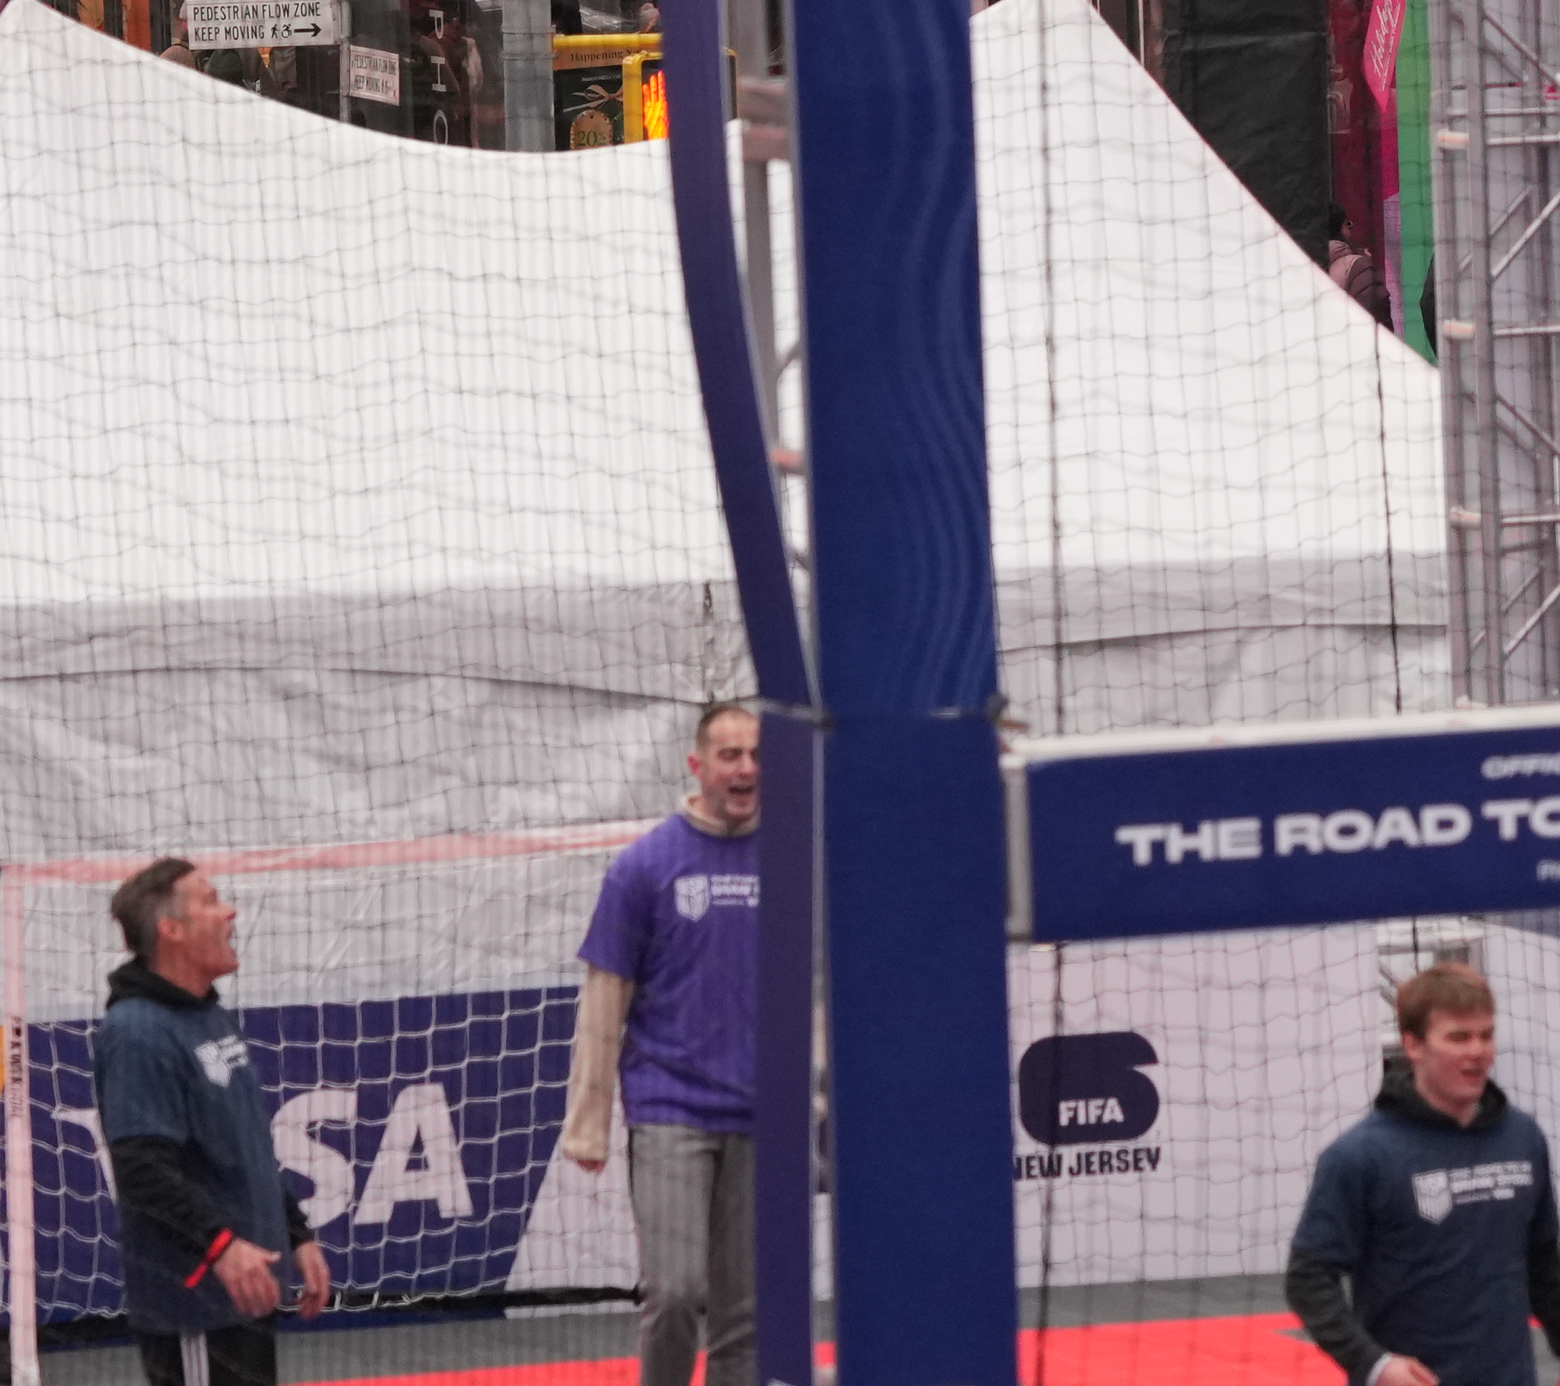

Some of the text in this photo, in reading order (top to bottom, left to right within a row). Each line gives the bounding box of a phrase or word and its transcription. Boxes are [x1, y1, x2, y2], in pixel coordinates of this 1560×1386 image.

[193, 0, 322, 22] PEDESTRIAN FLOW ZONE
[193, 23, 266, 42] KEEP MOVING
[1116, 821, 1262, 868] THE
[1274, 805, 1474, 857] ROAD
[1058, 1097, 1125, 1128] FIFA
[1067, 1144, 1162, 1176] JERSEY
